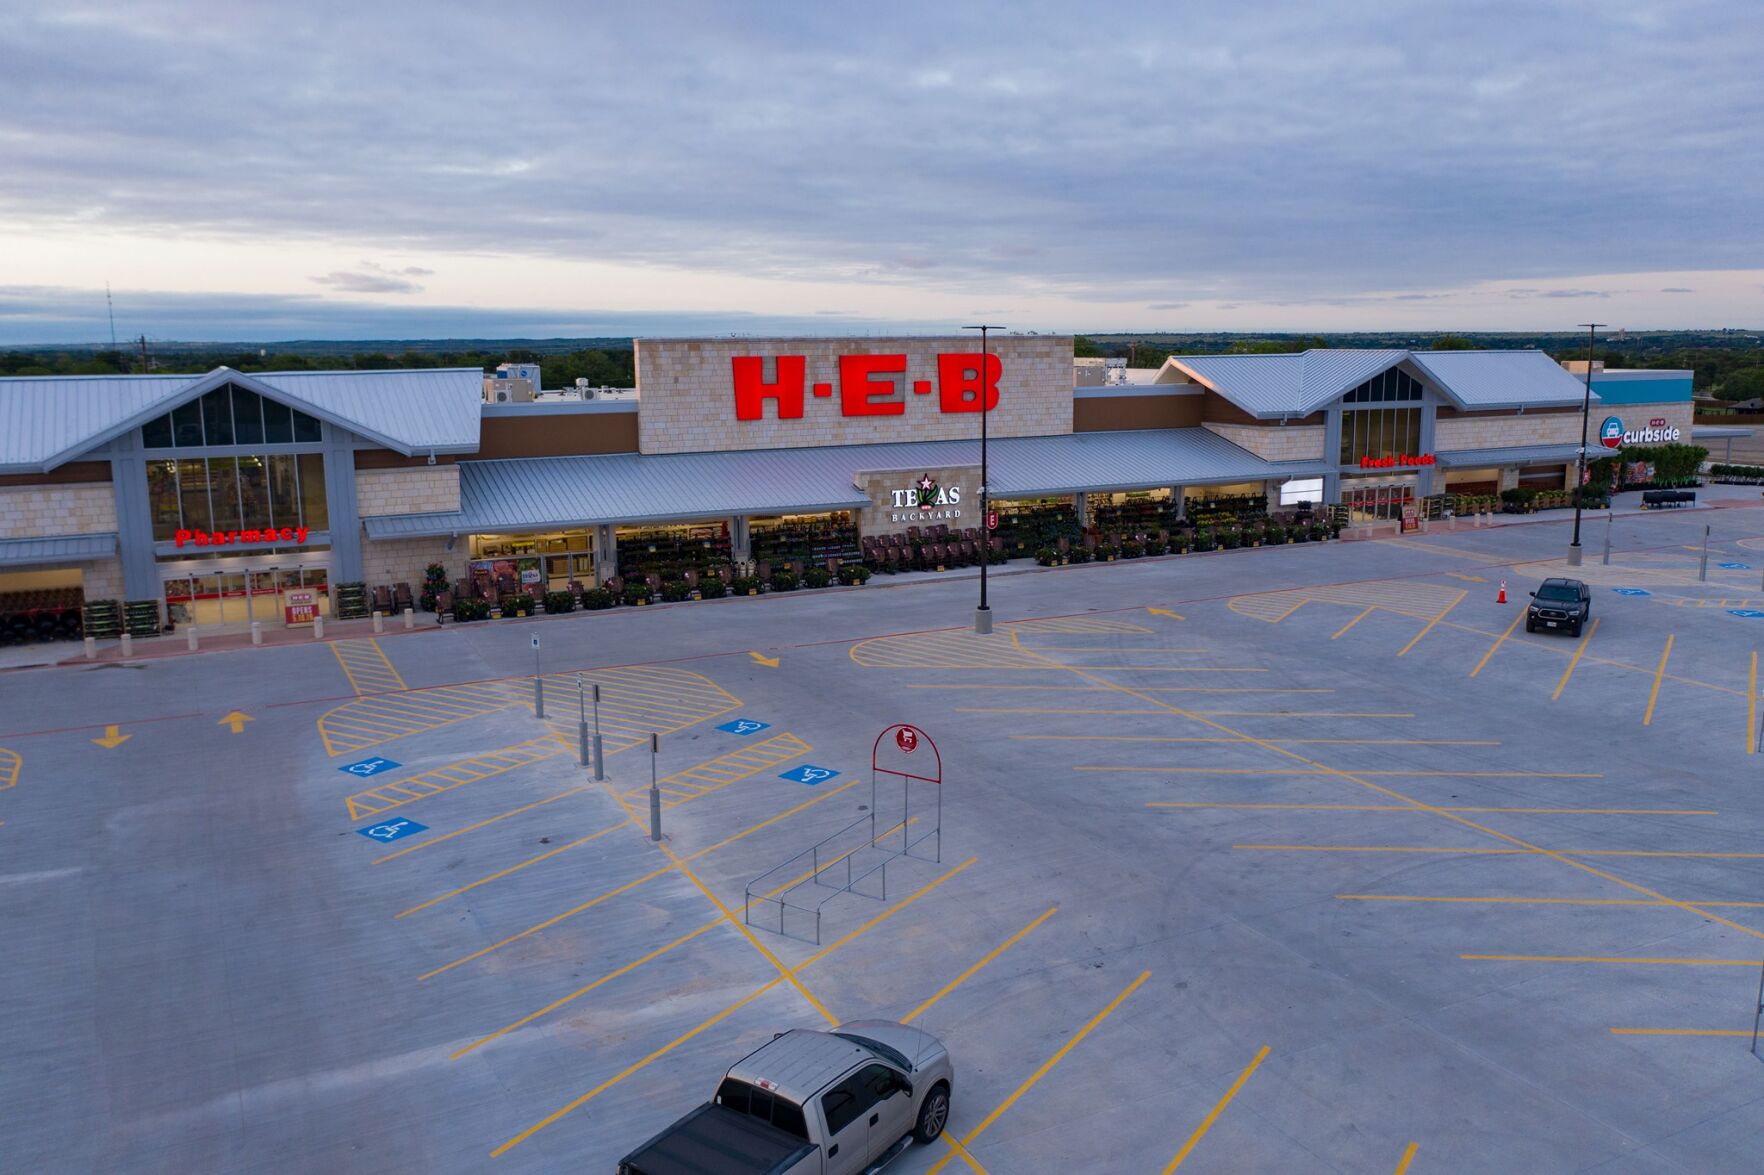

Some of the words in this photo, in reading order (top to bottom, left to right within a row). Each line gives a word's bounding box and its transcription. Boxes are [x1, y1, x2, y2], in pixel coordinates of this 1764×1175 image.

[1623, 426, 1680, 443] curbside
[1361, 456, 1395, 469] Fresh
[1400, 453, 1435, 466] Foods
[892, 510, 961, 522] BACKYARD
[990, 515, 995, 526] E
[175, 526, 309, 548] Pharmacy
